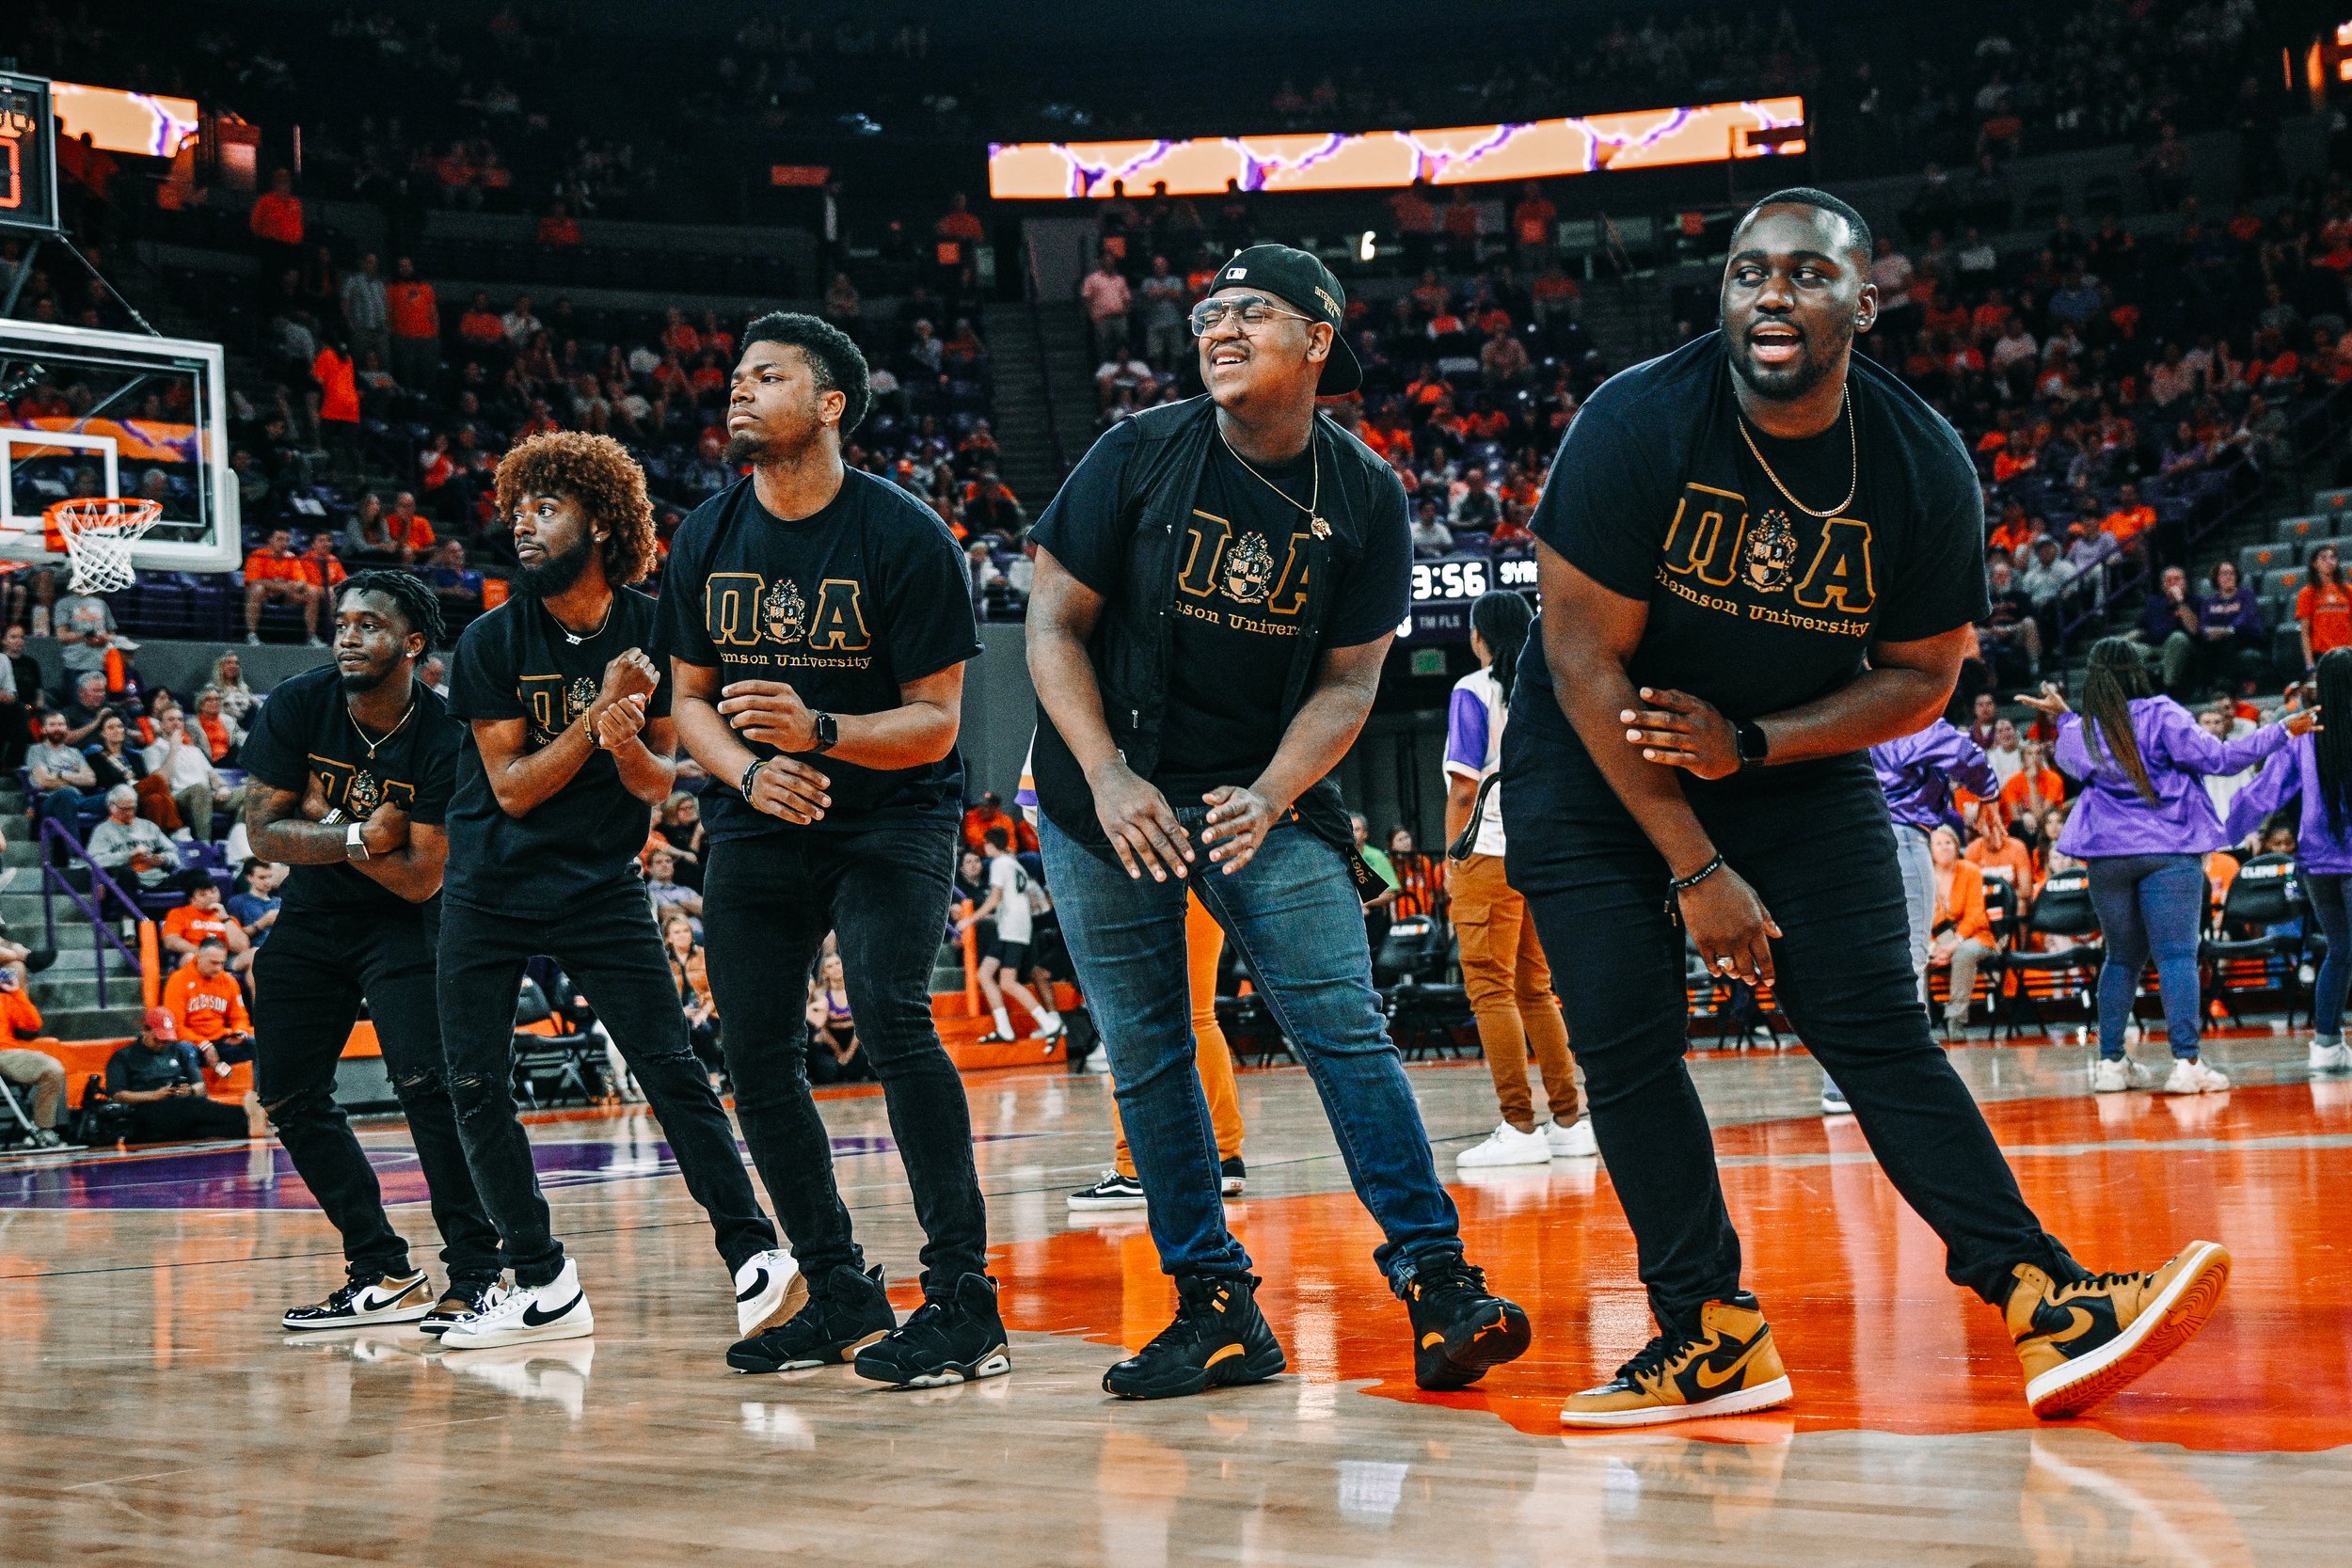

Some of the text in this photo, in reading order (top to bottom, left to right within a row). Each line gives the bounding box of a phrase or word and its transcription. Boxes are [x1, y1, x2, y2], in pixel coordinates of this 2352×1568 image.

[1411, 562, 1486, 600] 3:56
[1748, 604, 1870, 637] University
[774, 653, 872, 669] University
[1350, 855, 1369, 884] 1906
